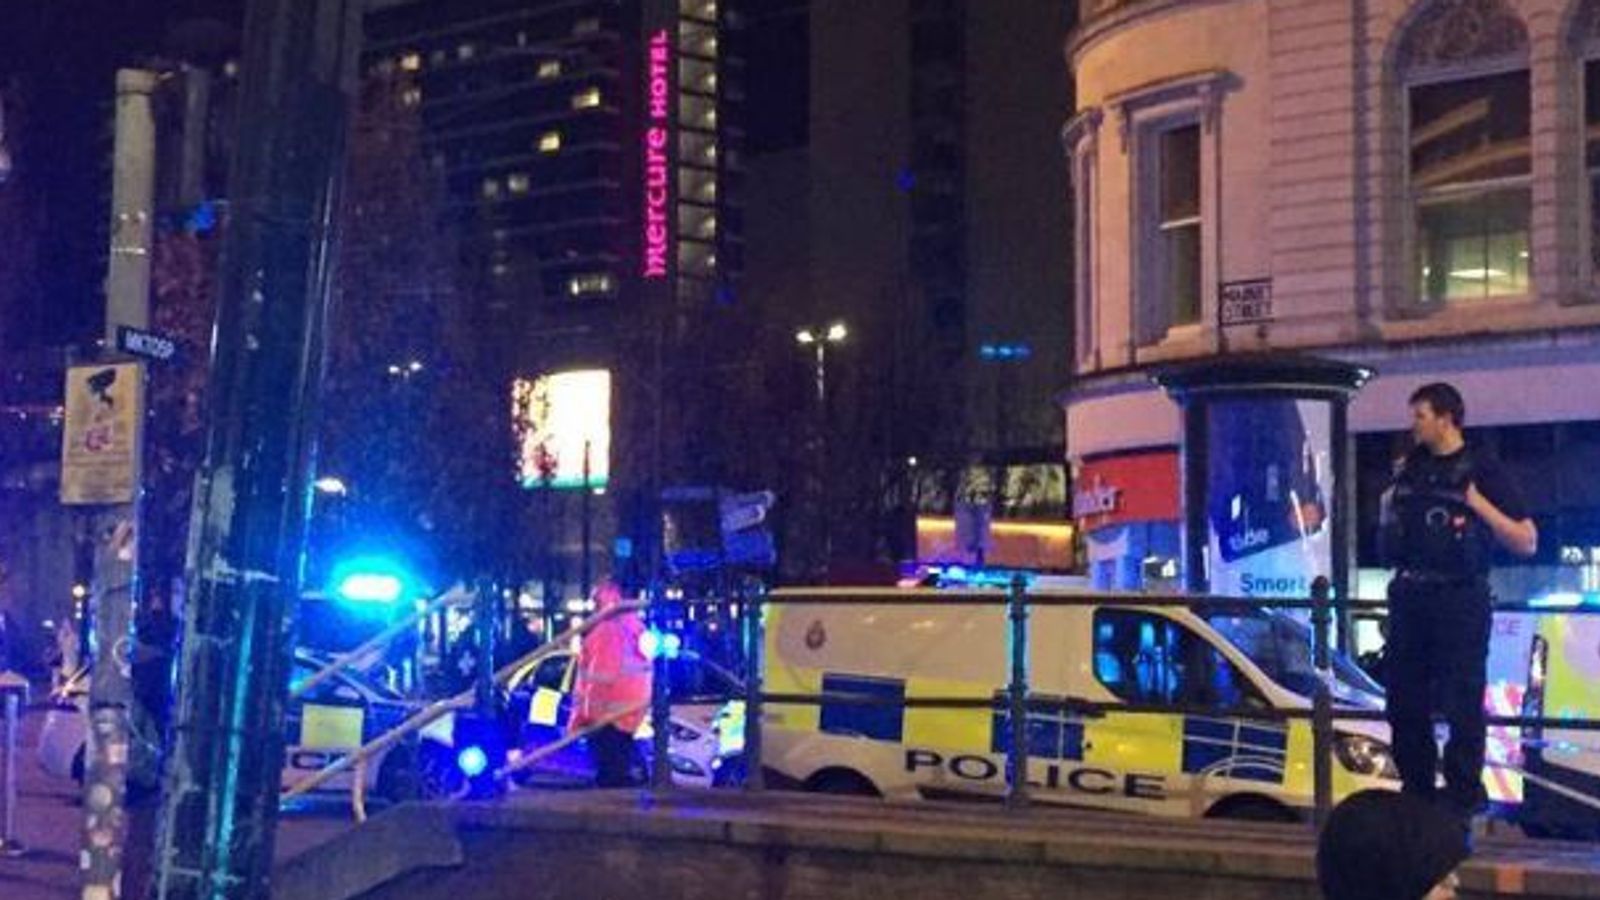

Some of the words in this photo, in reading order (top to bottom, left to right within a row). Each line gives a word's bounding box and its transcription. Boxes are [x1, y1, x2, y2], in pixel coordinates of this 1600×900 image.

[650, 29, 668, 118] HOTEL
[645, 128, 668, 277] mercure
[1240, 573, 1307, 592] Smart
